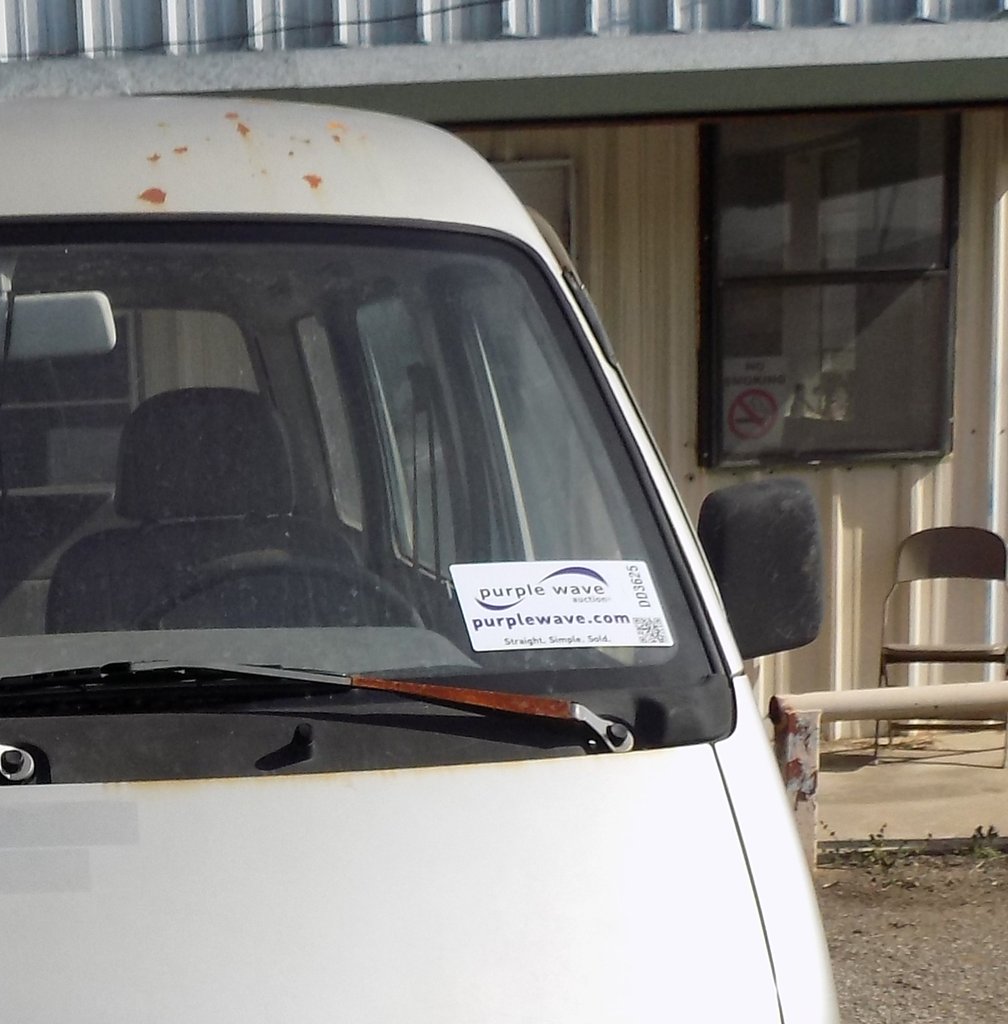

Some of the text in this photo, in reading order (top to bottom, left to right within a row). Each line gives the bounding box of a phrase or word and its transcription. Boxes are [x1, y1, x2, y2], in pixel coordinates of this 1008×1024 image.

[479, 584, 605, 600] purple wave
[472, 613, 630, 631] purplewave.com
[504, 635, 611, 646] Straight. Simple. Sold.
